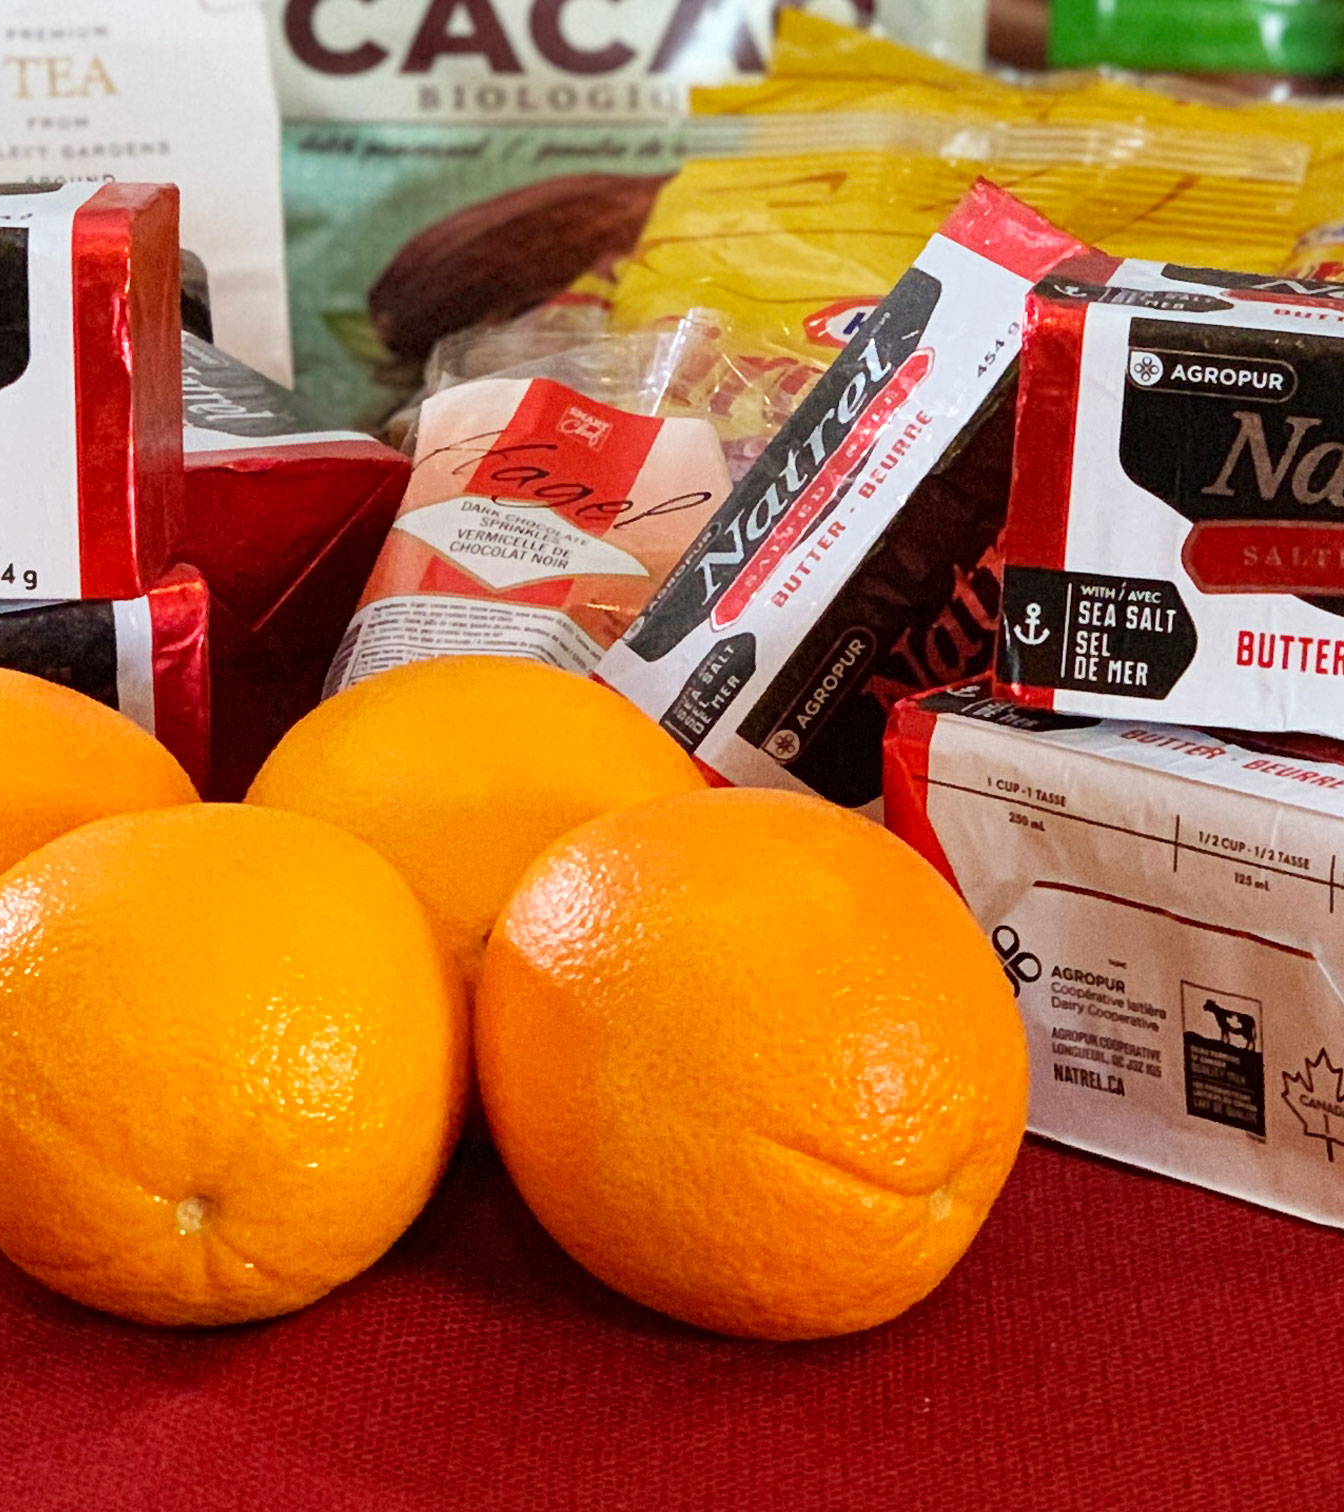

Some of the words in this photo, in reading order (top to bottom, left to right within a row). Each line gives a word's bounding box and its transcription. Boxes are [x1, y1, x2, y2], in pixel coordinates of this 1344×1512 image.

[5, 26, 110, 40] PREMIUM
[4, 56, 121, 99] TEA
[418, 85, 682, 116] BIOLOGIQ
[27, 116, 90, 129] FROM
[61, 141, 171, 157] GARDENS
[1169, 363, 1286, 392] AGROPUR
[693, 336, 893, 606] Natrel
[461, 501, 503, 518] DARK
[771, 519, 847, 610] BUTTER
[857, 408, 934, 501] BEURRE
[449, 540, 529, 561] CHOCOLAT
[532, 553, 569, 570] NOIR
[457, 529, 551, 555] VERMICELLE
[552, 546, 571, 559] DE
[22, 568, 39, 591] g
[1080, 584, 1117, 600] WITH
[1128, 590, 1163, 604] AVEC
[1077, 602, 1120, 629] SEA
[1125, 605, 1177, 634] SALT
[1075, 630, 1112, 658] SEL
[796, 636, 867, 729] AGROPUR
[1074, 655, 1103, 681] DE
[1108, 658, 1150, 687] MER
[1119, 727, 1229, 761] BUTTER
[995, 779, 1022, 795] CUP
[1033, 787, 1068, 808] TASSE
[1197, 829, 1220, 847] 1/2
[1220, 835, 1246, 855] CUP
[1276, 850, 1311, 871] TASSE
[1233, 871, 1254, 889] 125
[1050, 965, 1126, 994] AGROPUR
[1050, 982, 1125, 1009] Coopérative
[1050, 995, 1086, 1015] Dairy
[1087, 1003, 1160, 1032] Cooperative
[1053, 1062, 1126, 1097] NATREL.CA
